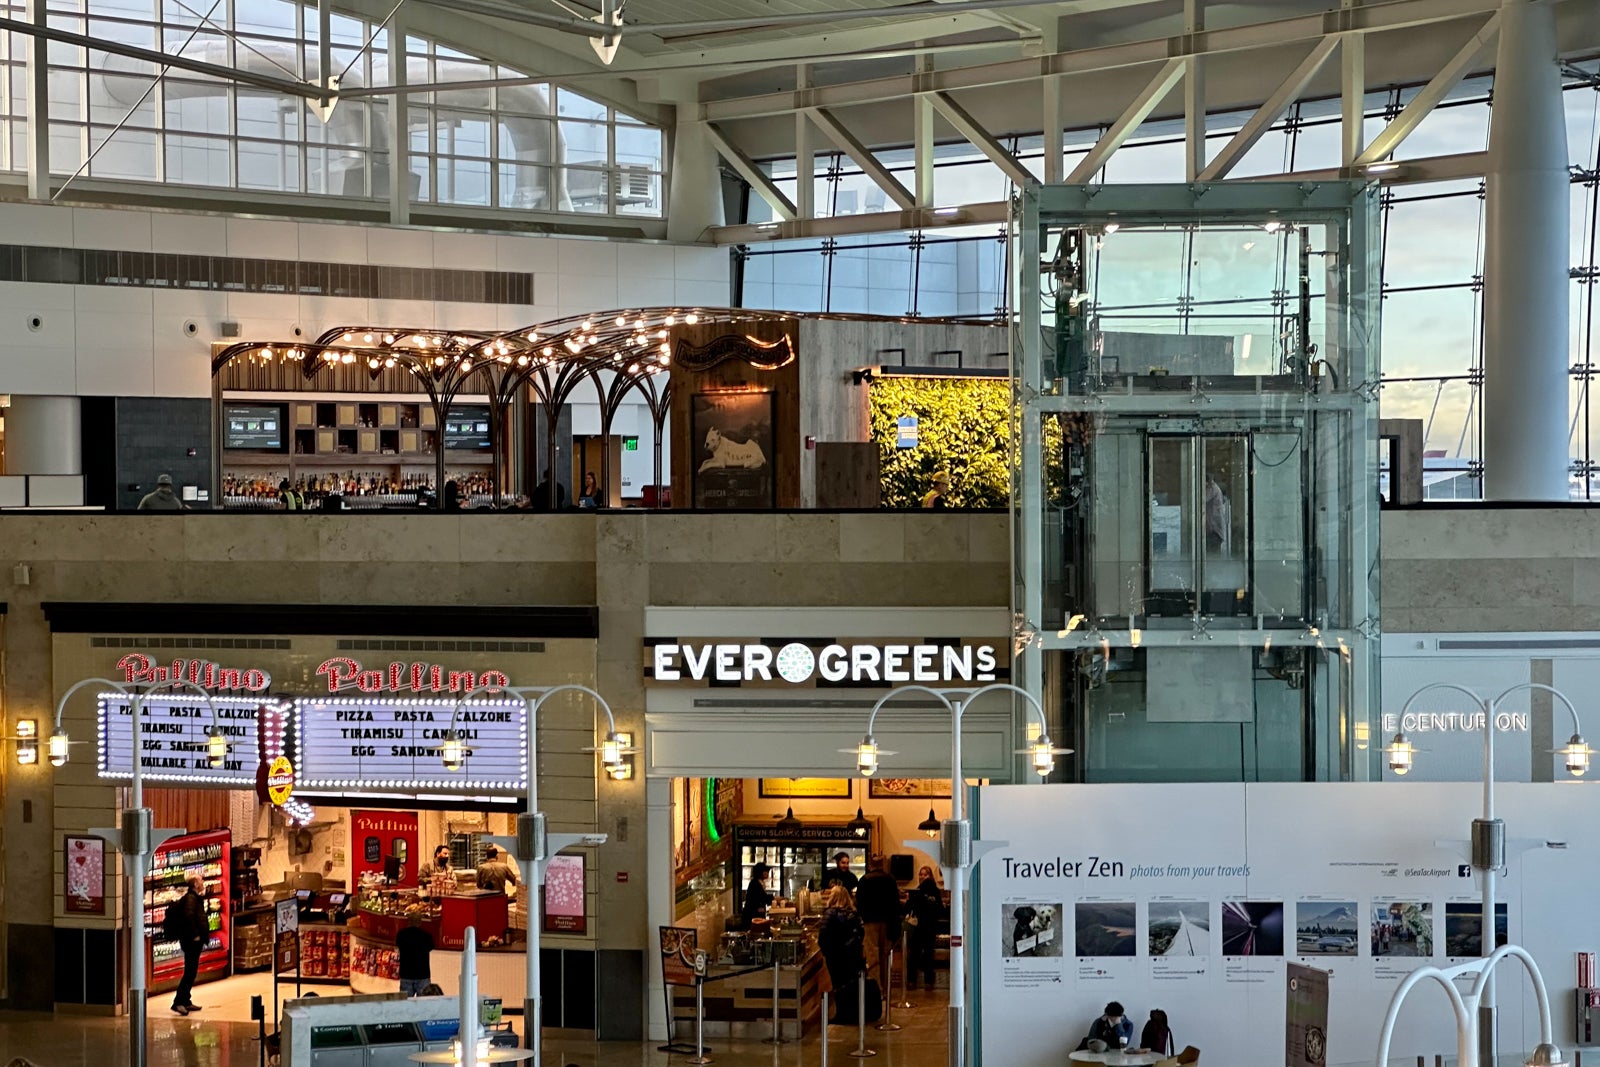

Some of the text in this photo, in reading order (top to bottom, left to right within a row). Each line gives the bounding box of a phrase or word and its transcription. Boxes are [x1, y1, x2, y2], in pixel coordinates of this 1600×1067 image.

[654, 644, 996, 682] EVER GREENS
[116, 653, 267, 692] Pallino
[316, 656, 508, 693] Pallino
[119, 705, 258, 720] PIZA PASTA CALZON
[336, 711, 512, 722] PIZZA PASTA CALZONE
[1403, 712, 1528, 731] CENTURON
[140, 722, 246, 737] IRAMISU CNOLI
[341, 728, 478, 739] TIRAMISU CANOLI
[143, 739, 234, 754] EGG SANDWIS
[352, 745, 473, 757] EGG SANDWIS
[140, 756, 187, 769] VAILABLE
[224, 760, 243, 772] DAY
[357, 818, 417, 832] Pallino
[833, 829, 866, 838] QUICK
[1002, 857, 1251, 881] Traveler Zen photos from your travels
[1404, 867, 1451, 878] @SeaTacAirport
[442, 935, 464, 945] Cann
[319, 1025, 352, 1033] Compost
